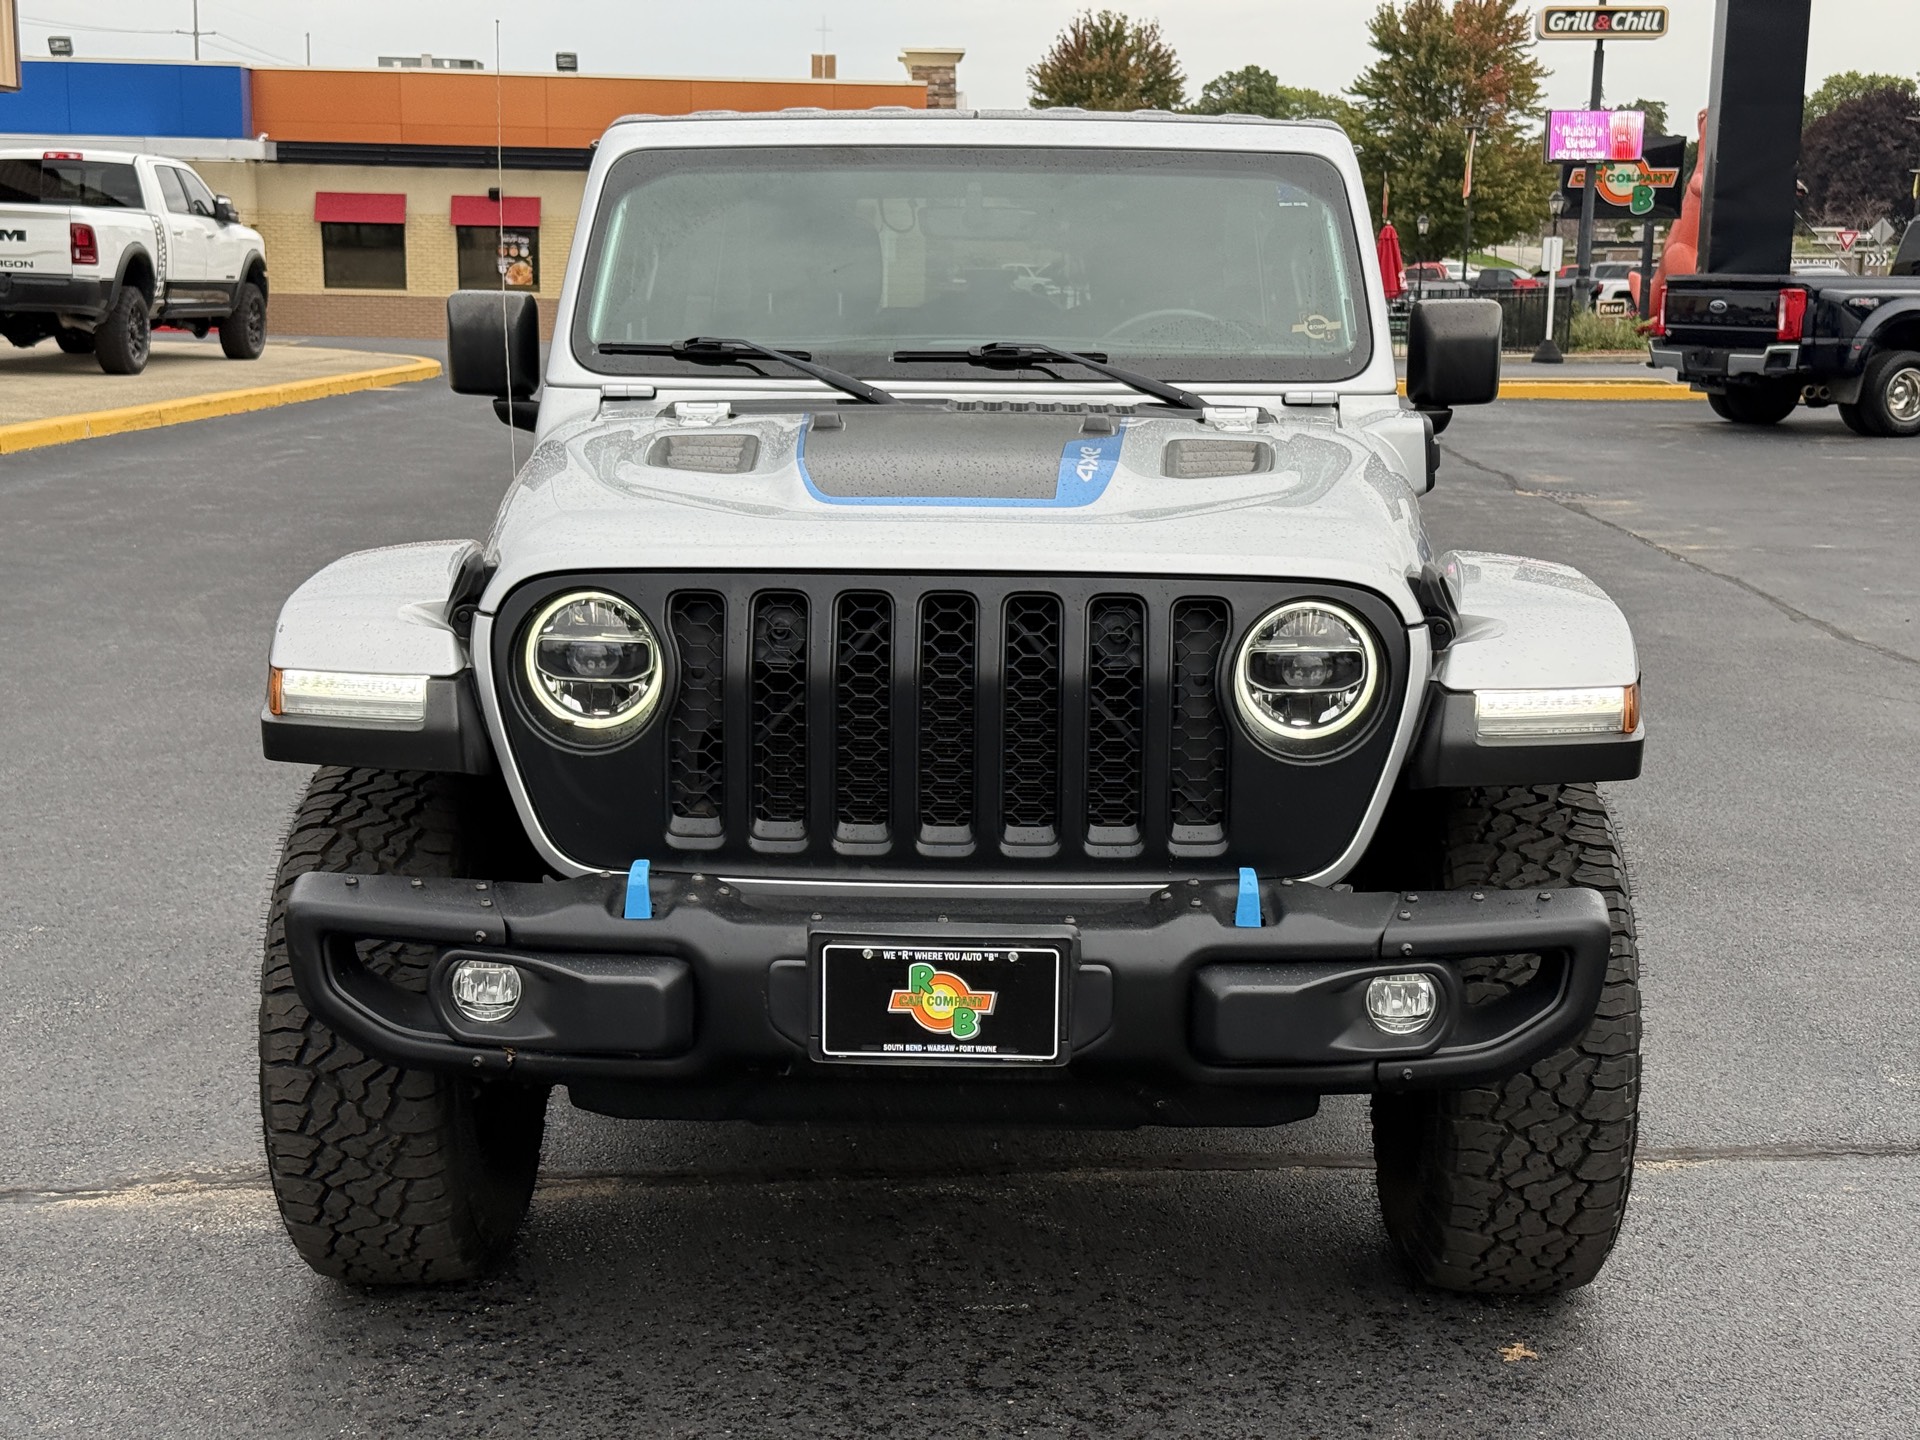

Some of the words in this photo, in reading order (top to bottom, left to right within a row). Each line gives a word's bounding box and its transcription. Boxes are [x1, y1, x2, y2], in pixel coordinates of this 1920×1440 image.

[1575, 174, 1604, 183] CR
[1632, 185, 1655, 213] B
[0, 260, 34, 268] GON
[883, 950, 896, 960] WE
[897, 950, 913, 960] "R"
[914, 952, 943, 961] WHERE
[944, 952, 960, 961] YOU
[961, 953, 982, 961] AUTO
[984, 953, 999, 961] "B"
[910, 964, 934, 994] R
[900, 994, 923, 1007] CAR
[926, 995, 985, 1007] COMPANY
[953, 1007, 977, 1037] B
[883, 1043, 904, 1052] SOUTH
[905, 1044, 923, 1052] BEND
[926, 1044, 955, 1052] WARSAW
[959, 1045, 975, 1053] FORT
[975, 1045, 998, 1054] WAYNE
